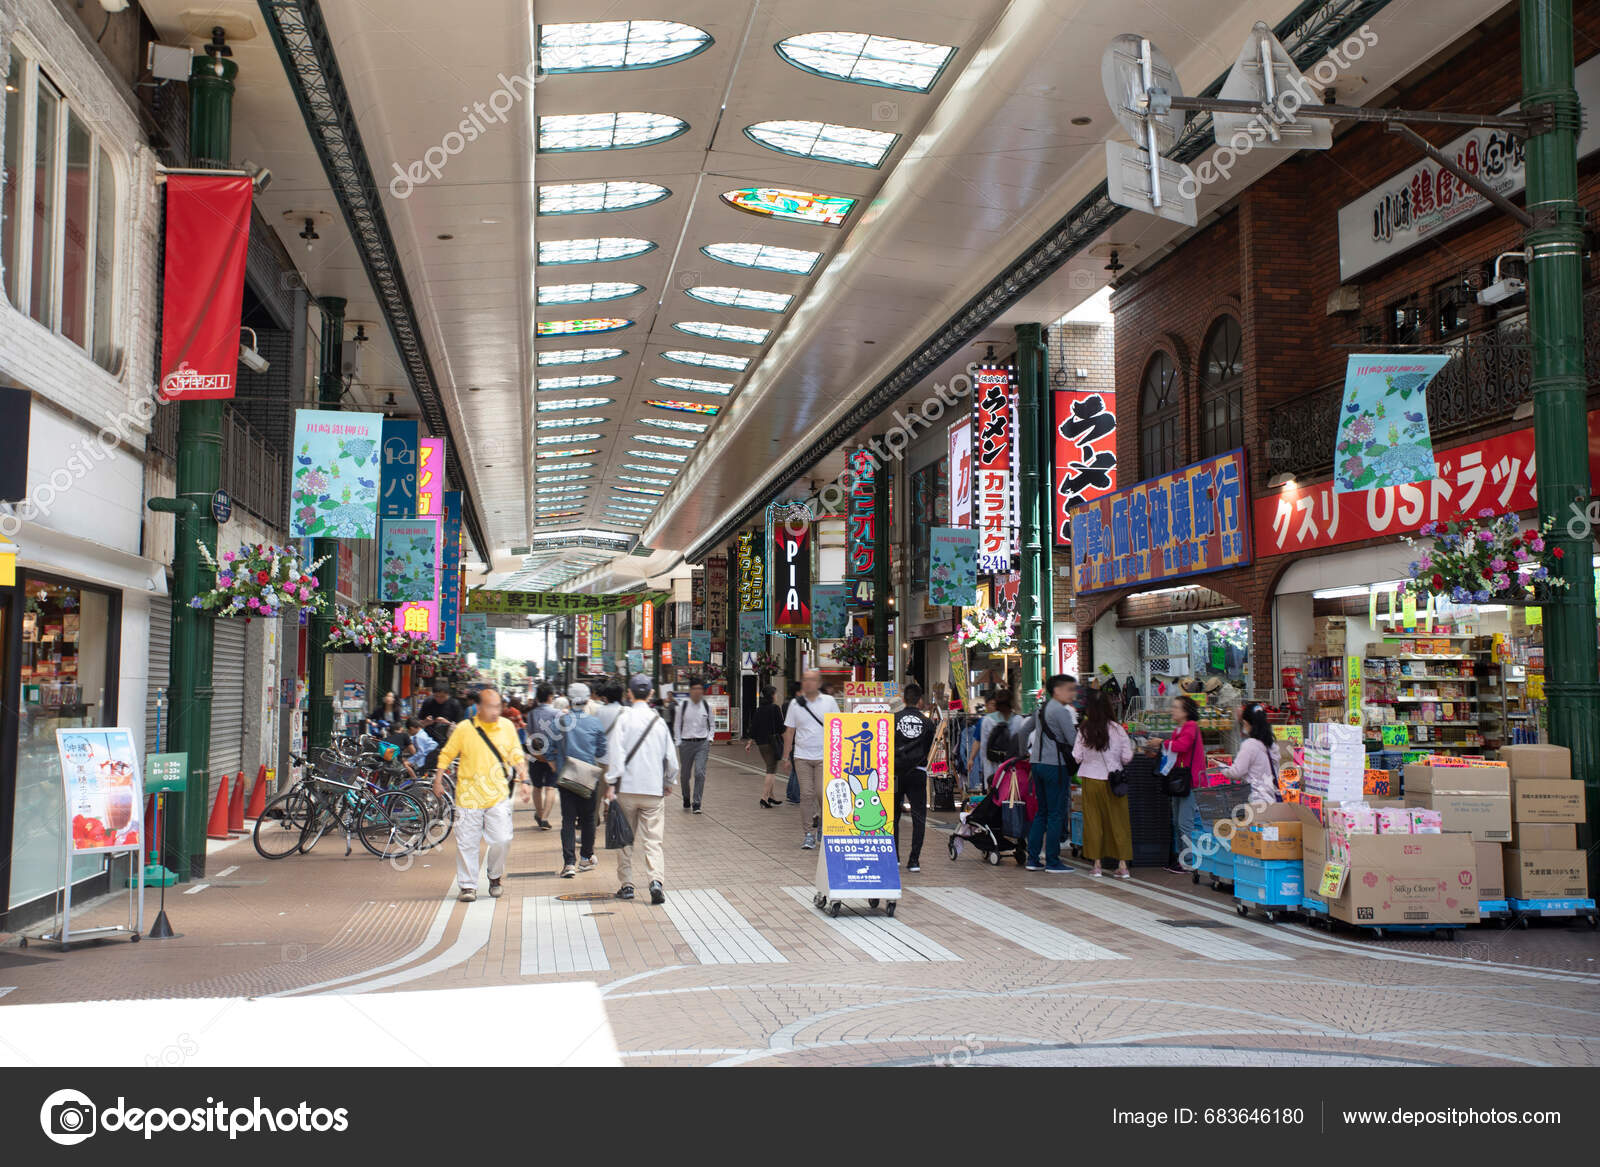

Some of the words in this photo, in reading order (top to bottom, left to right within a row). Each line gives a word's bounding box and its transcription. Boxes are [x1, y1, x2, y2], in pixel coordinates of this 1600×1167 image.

[981, 386, 1008, 464] ラーメン
[984, 472, 1006, 552] カラオケ
[1273, 486, 1341, 550] クスリ
[787, 540, 799, 611] PIA
[982, 555, 1008, 569] 24h
[846, 683, 877, 697] 24H
